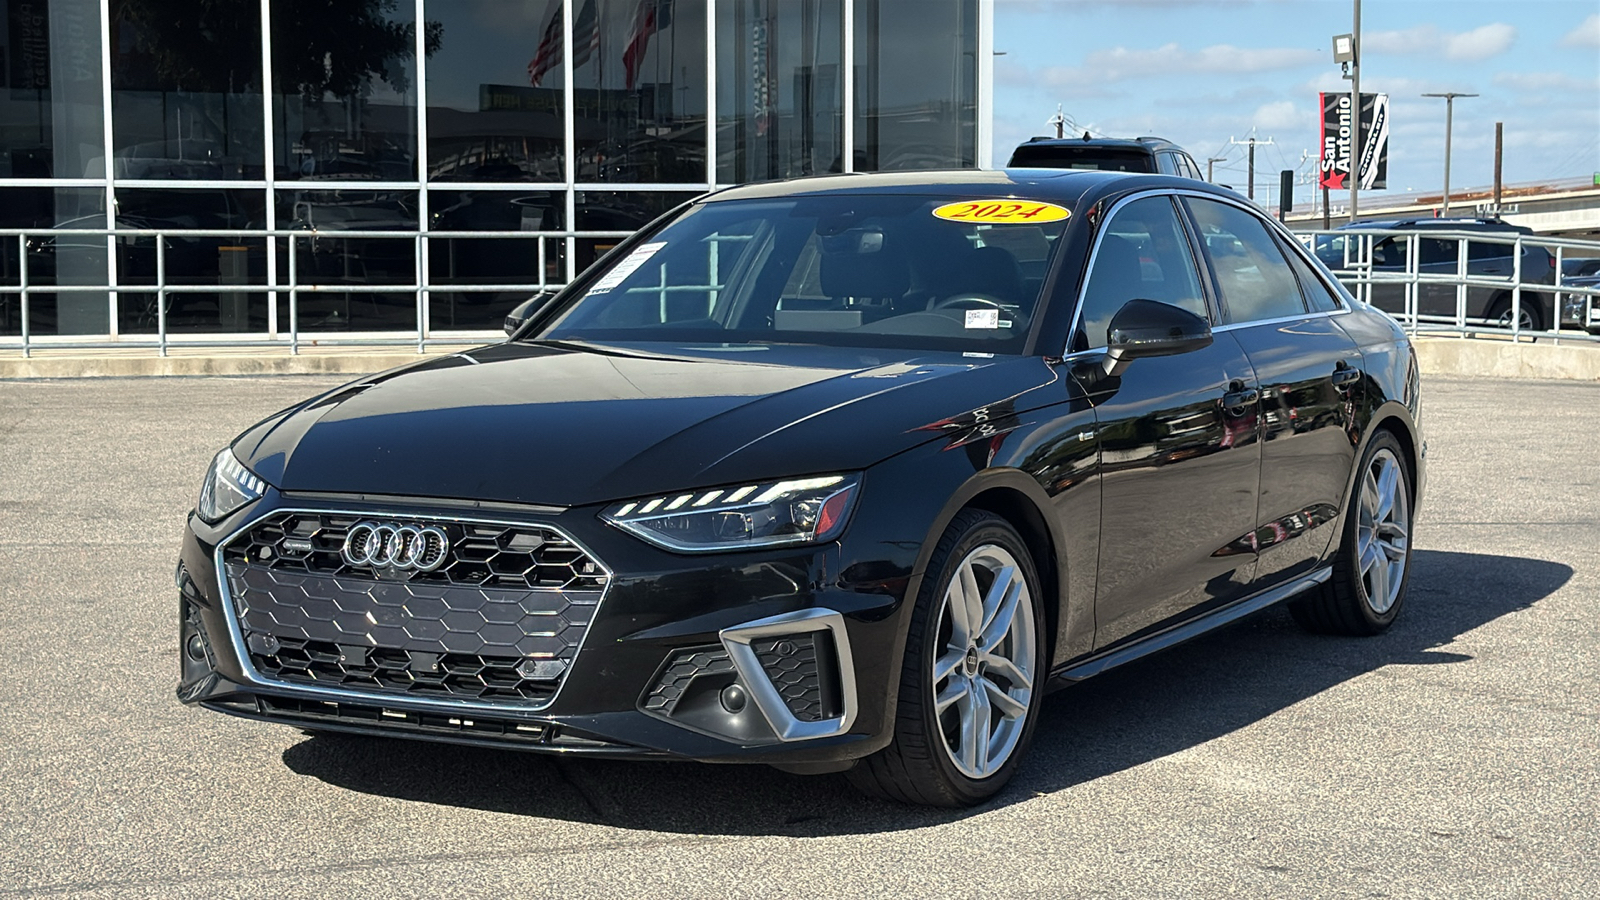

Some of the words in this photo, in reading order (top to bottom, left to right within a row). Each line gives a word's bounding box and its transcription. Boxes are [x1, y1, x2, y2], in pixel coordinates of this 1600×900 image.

[1321, 136, 1336, 172] San
[1336, 97, 1351, 173] Antonio
[1361, 113, 1384, 176] CHRYSLER
[950, 204, 1048, 218] 2024
